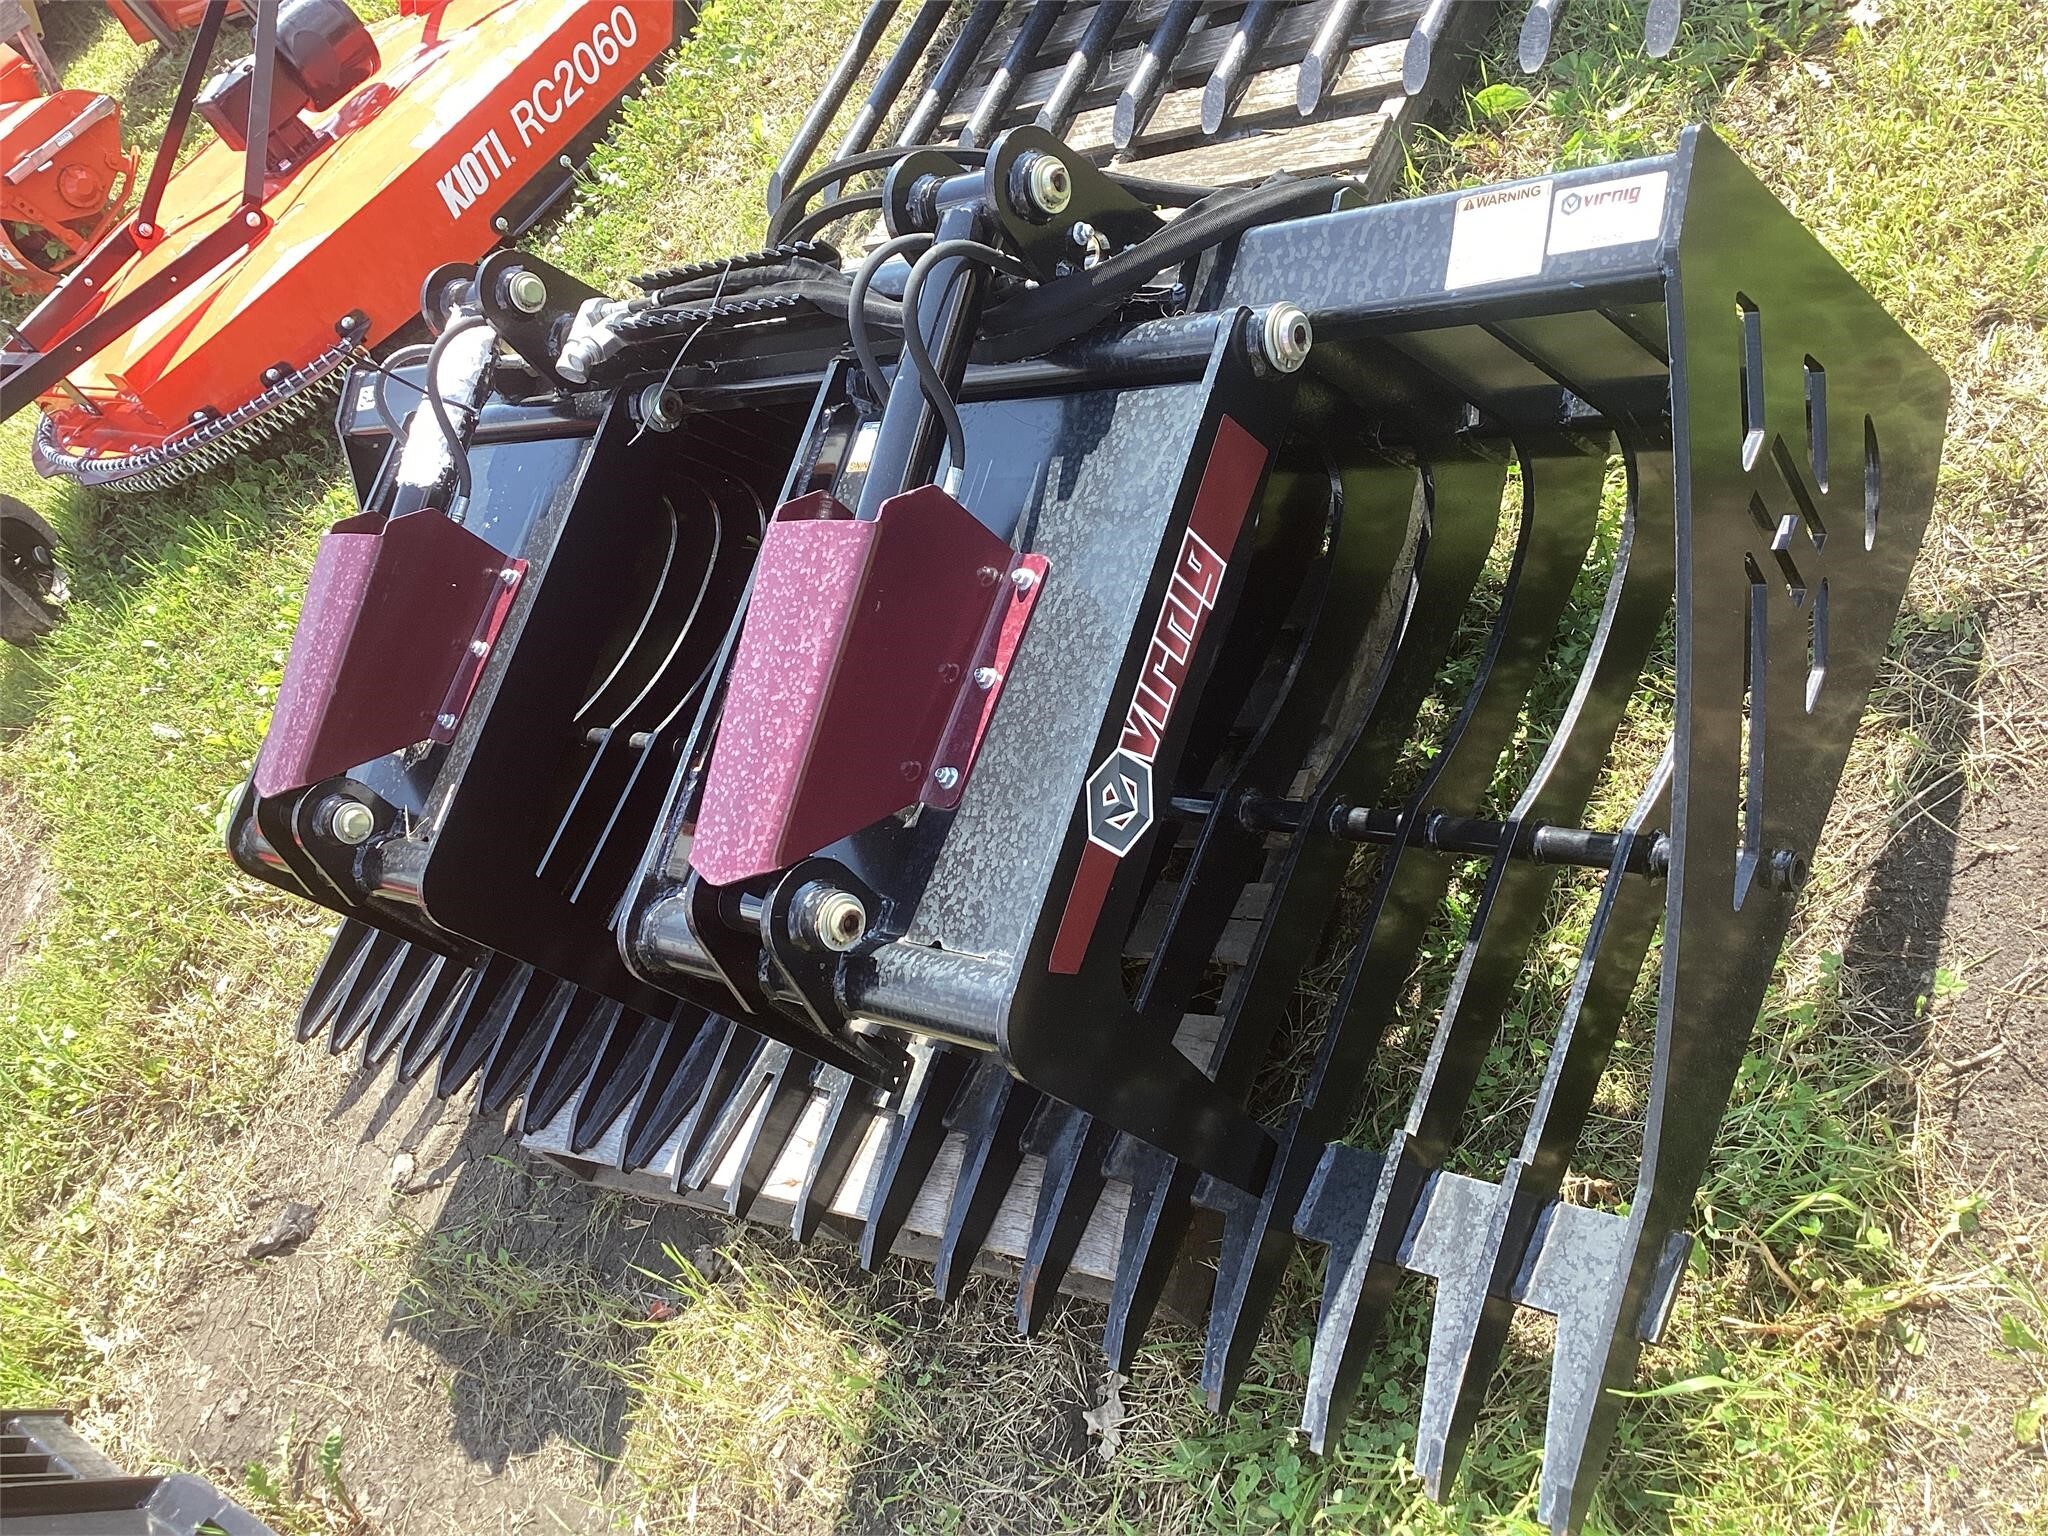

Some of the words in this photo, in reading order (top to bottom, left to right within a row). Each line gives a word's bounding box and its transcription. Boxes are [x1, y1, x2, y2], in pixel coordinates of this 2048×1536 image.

[436, 128, 513, 220] KIOTI
[509, 5, 638, 149] RC2060
[1476, 185, 1541, 209] WARNING
